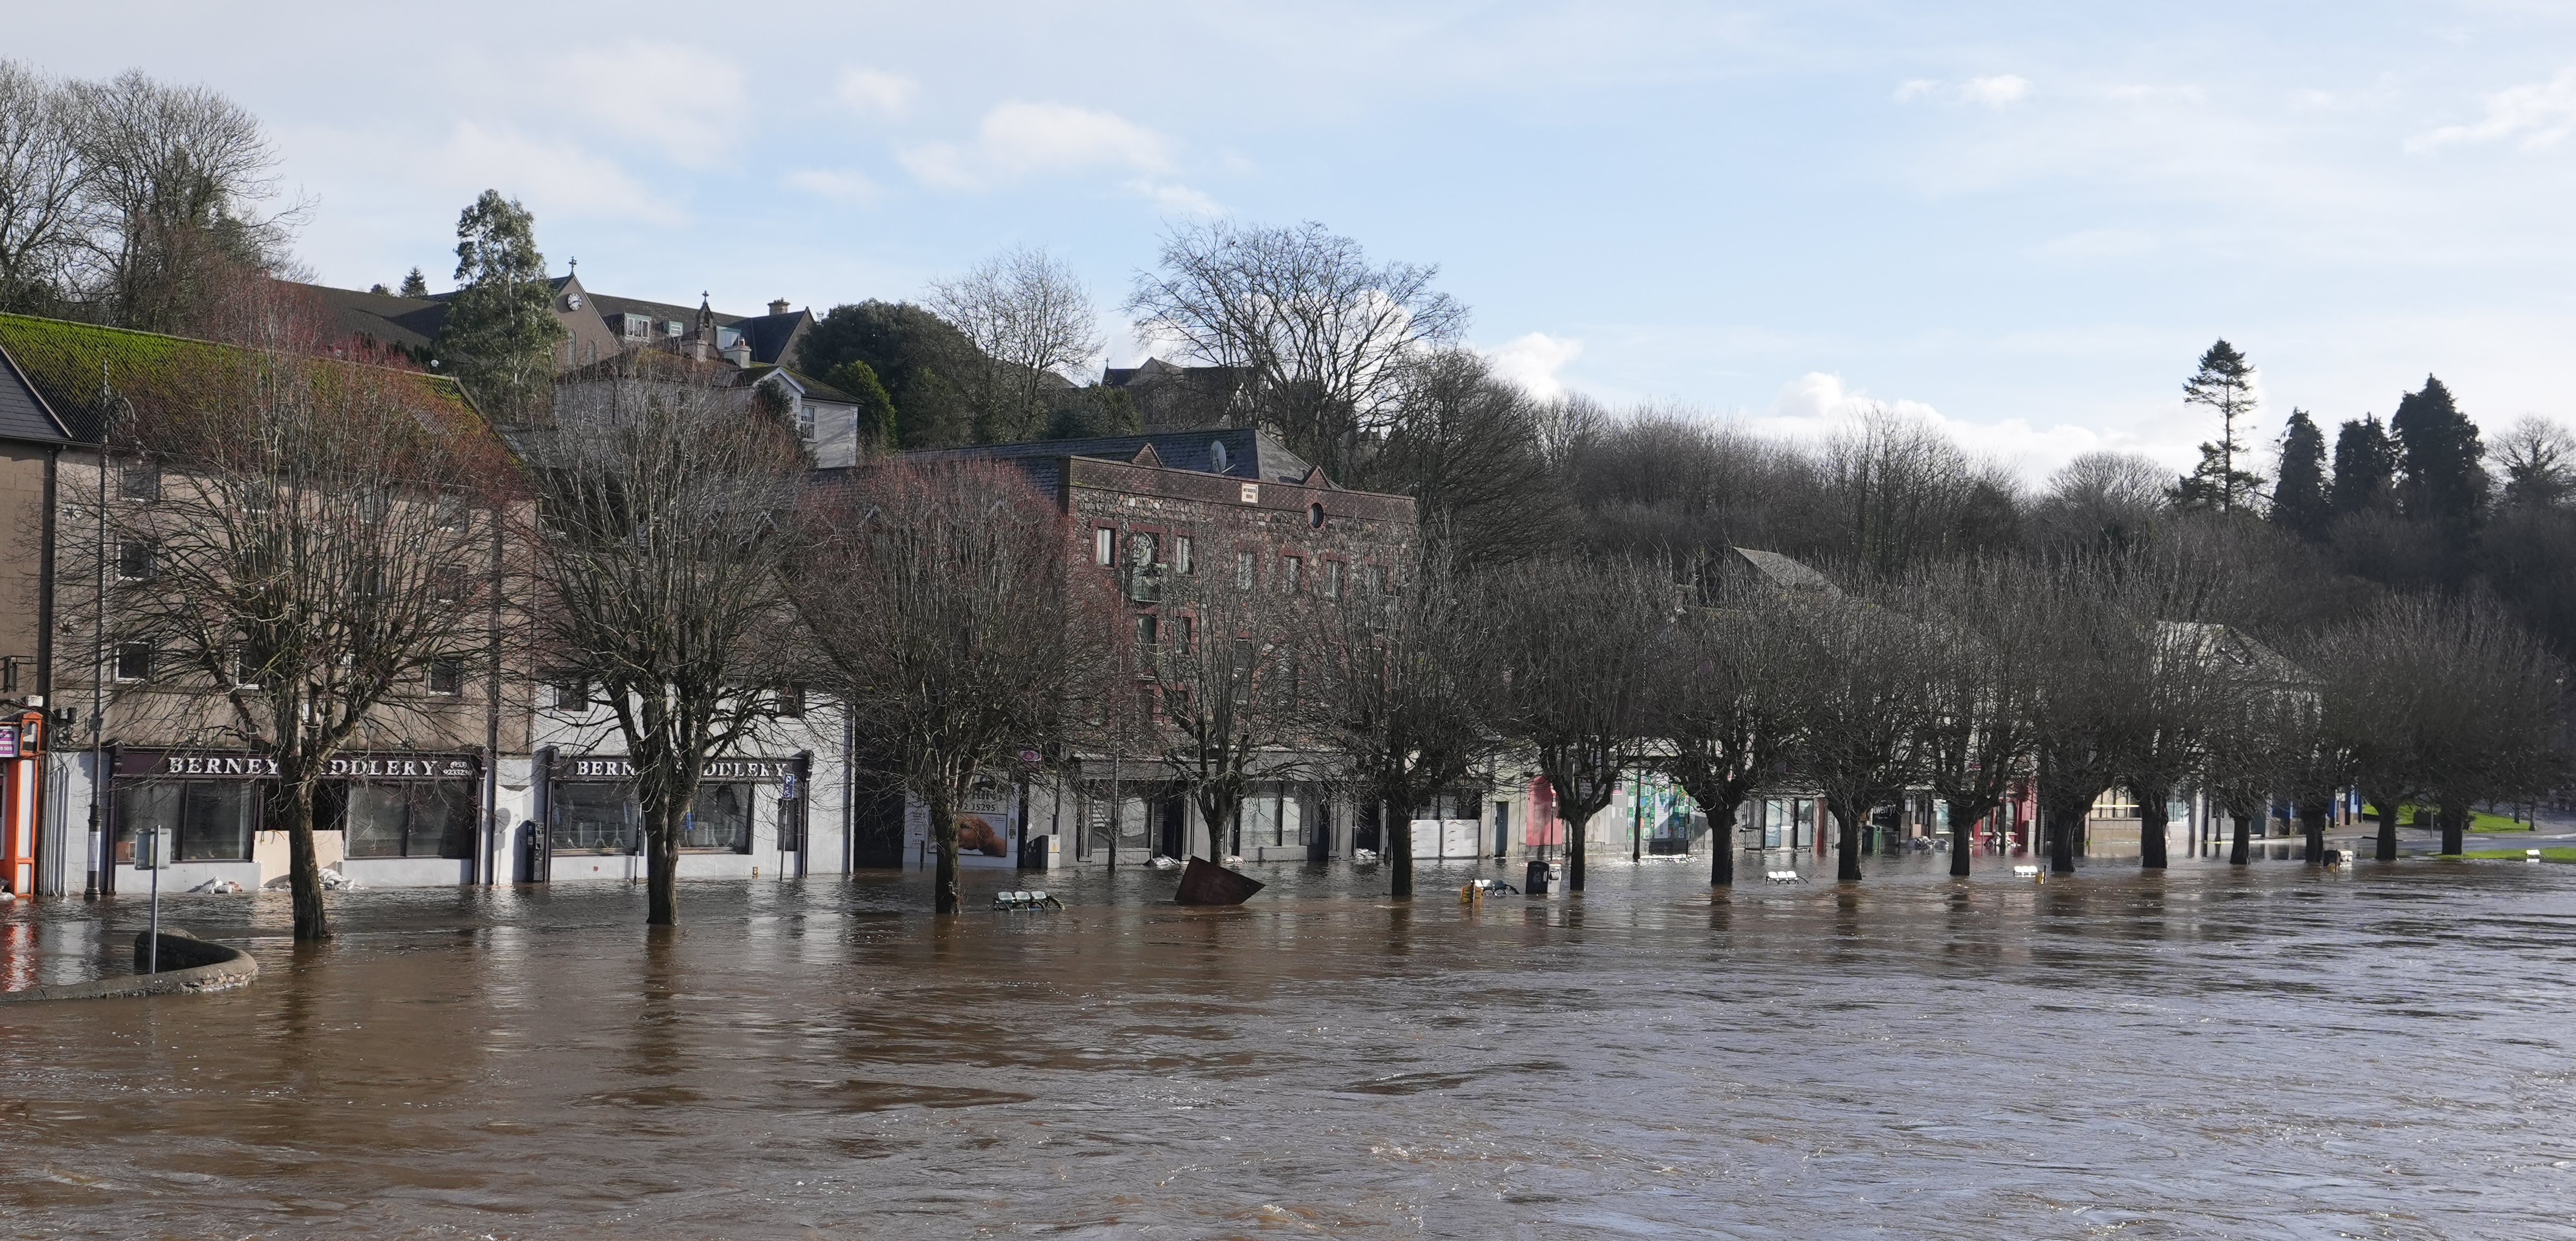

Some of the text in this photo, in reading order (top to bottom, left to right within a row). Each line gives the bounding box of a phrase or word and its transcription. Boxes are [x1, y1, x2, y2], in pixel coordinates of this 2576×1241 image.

[169, 757, 438, 775] BERNEY DDLERY
[576, 761, 636, 776] BERN
